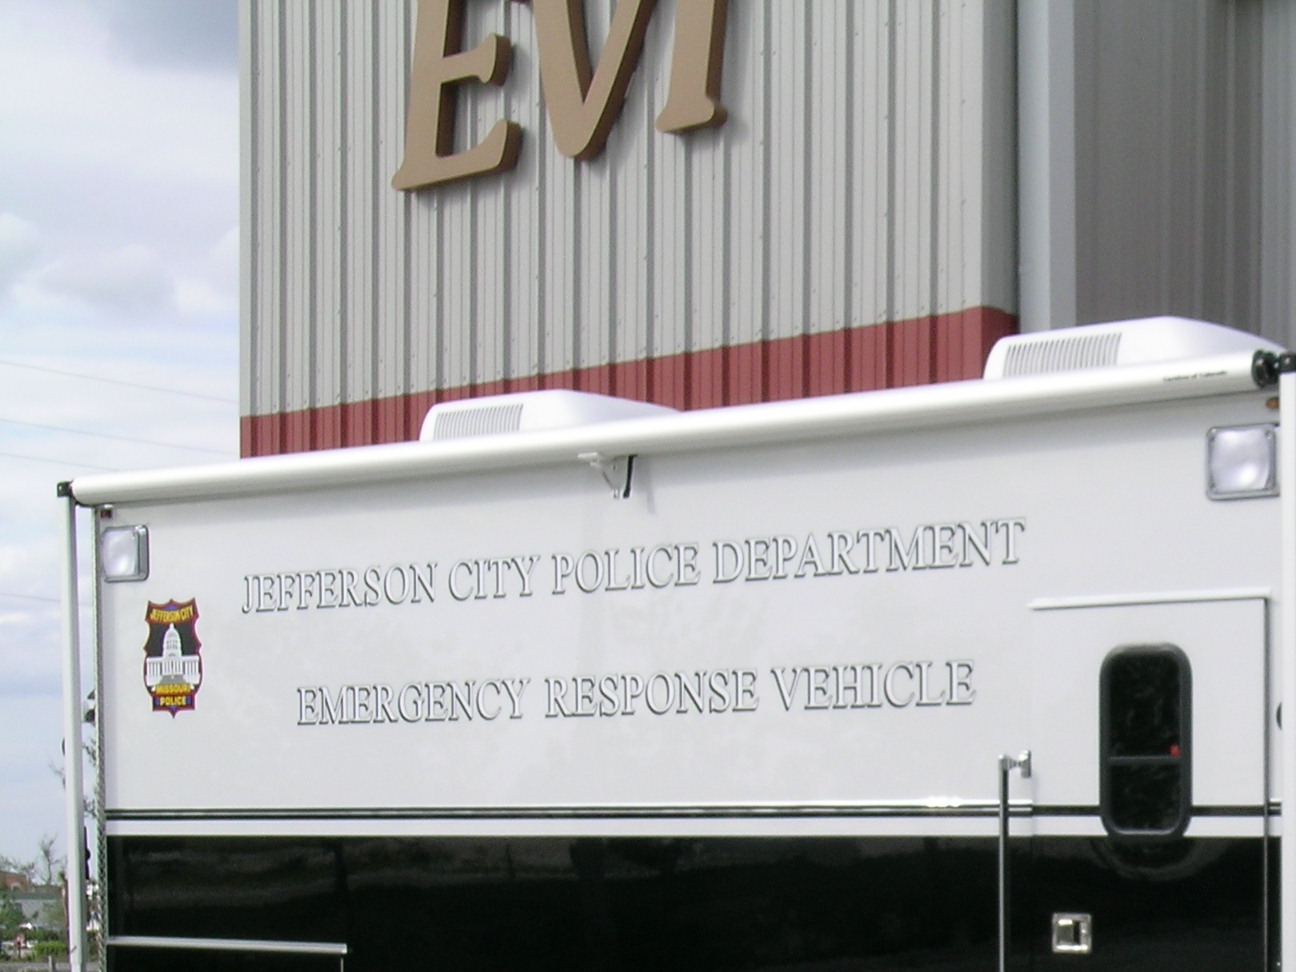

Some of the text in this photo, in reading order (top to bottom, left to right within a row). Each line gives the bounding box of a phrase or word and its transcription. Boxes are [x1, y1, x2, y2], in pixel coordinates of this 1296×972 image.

[391, 0, 728, 191] EVI
[241, 516, 1026, 614] JEFFERSON CITY POLICE DEPARTMENT
[159, 696, 187, 706] POLICE
[296, 659, 977, 726] EMERGENCY RESPONSE VEHICLE
